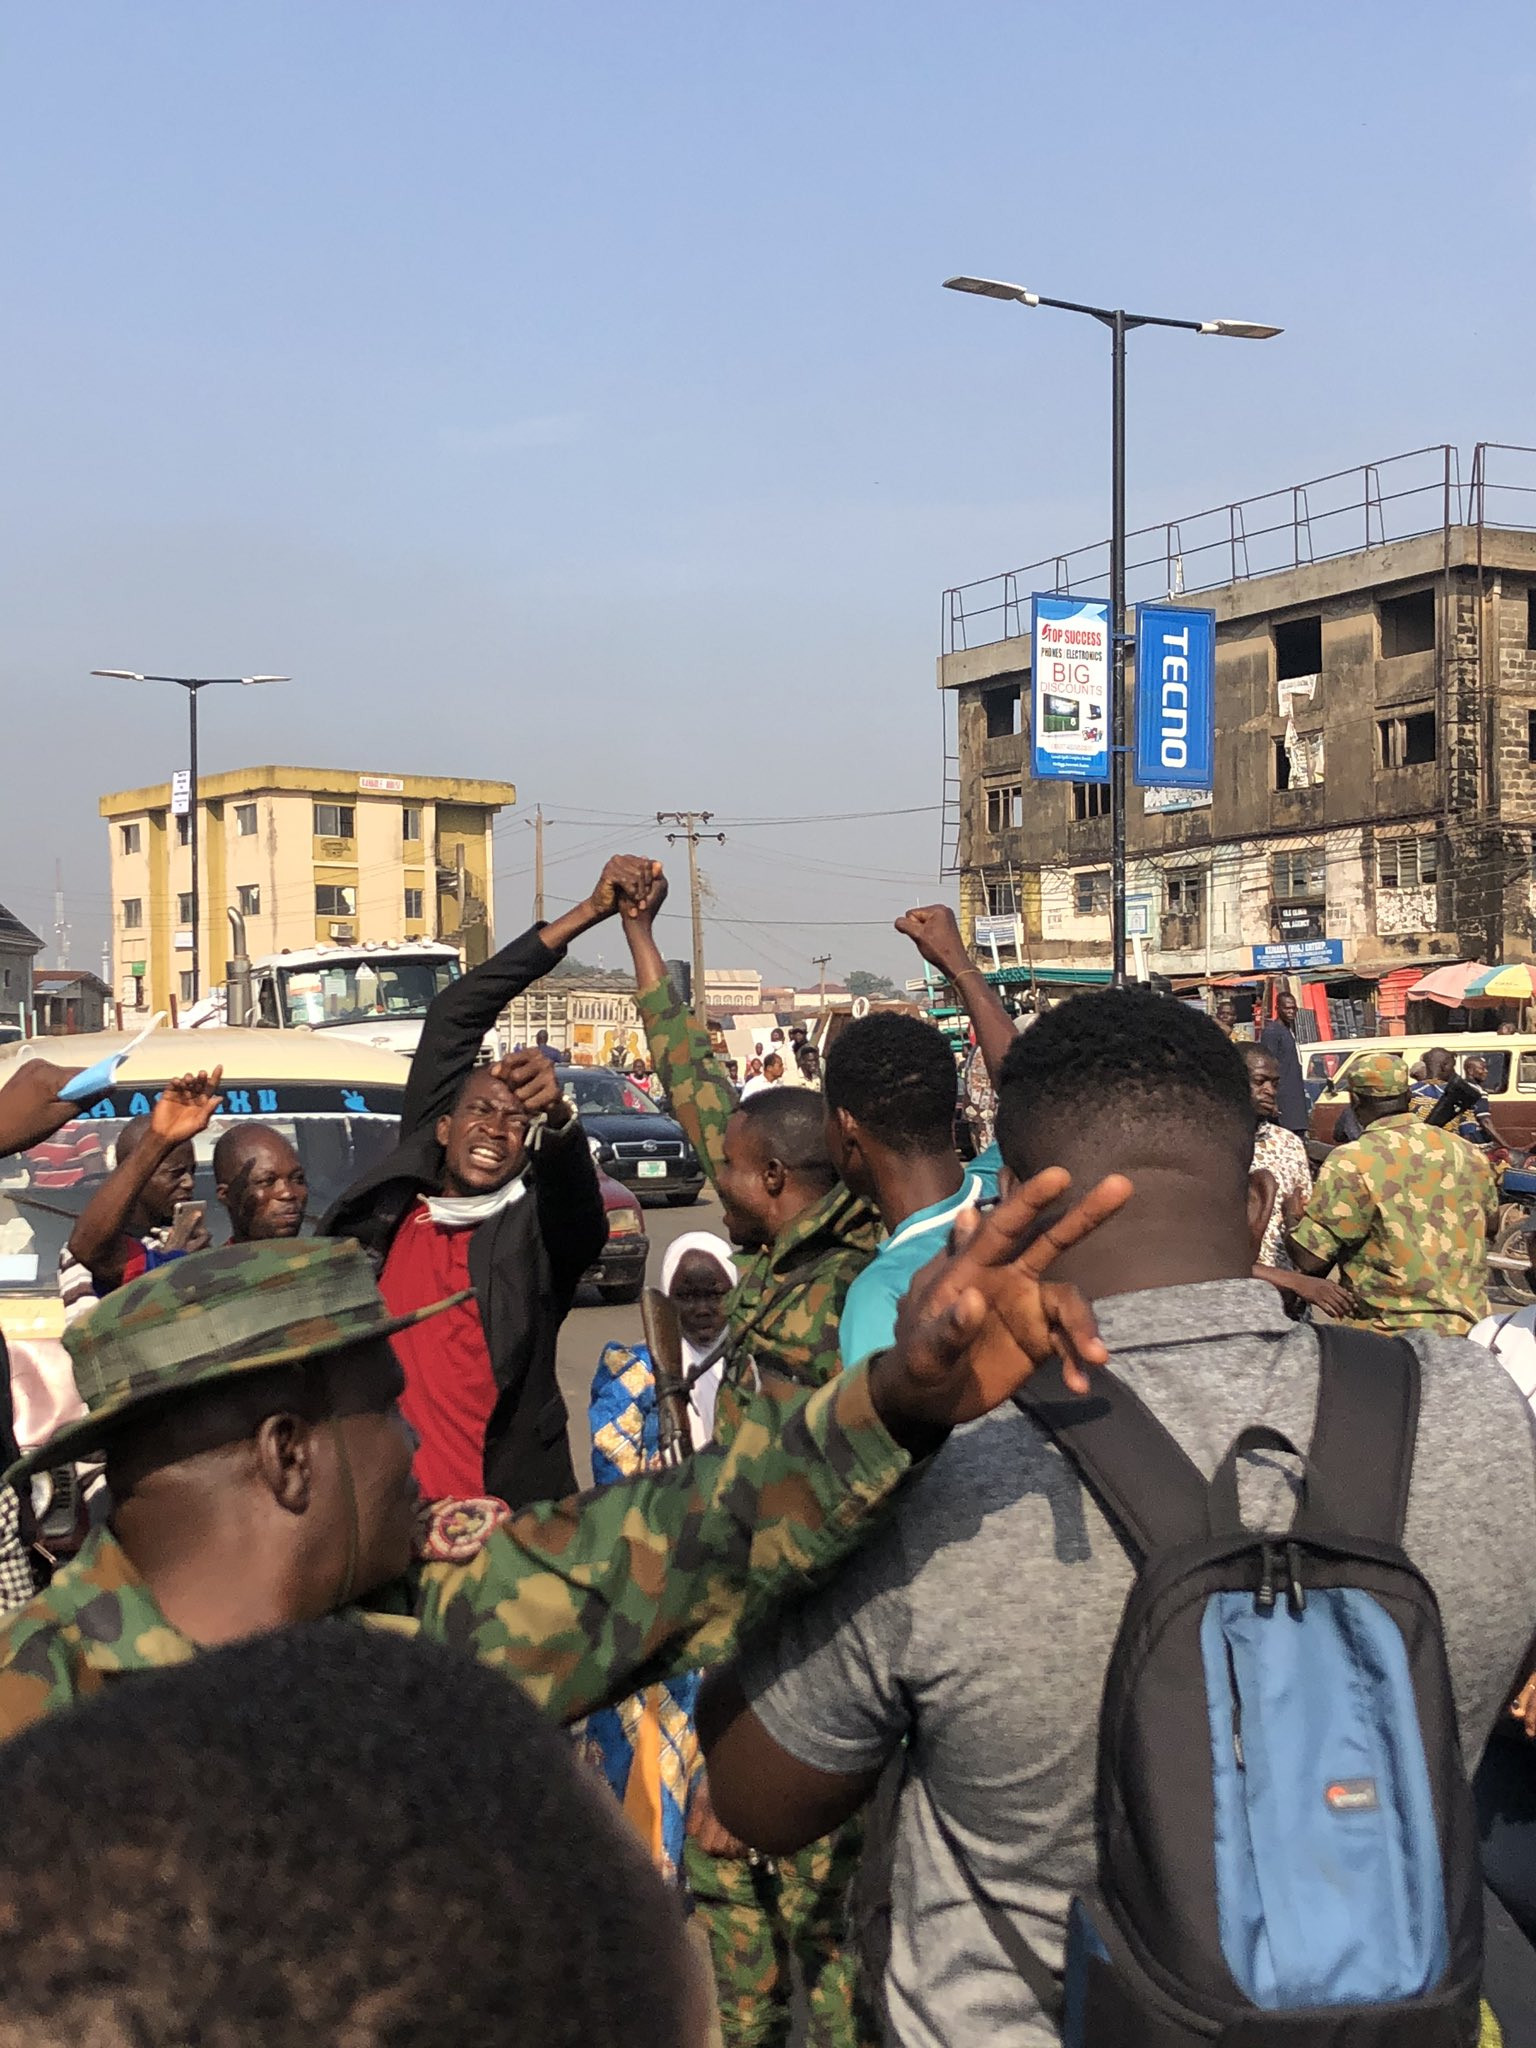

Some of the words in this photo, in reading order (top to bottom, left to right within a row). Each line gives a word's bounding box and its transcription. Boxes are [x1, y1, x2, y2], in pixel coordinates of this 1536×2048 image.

[1047, 628, 1063, 642] TOP
[1064, 629, 1102, 647] SUCCESS
[1041, 647, 1063, 659] PHONES
[1066, 648, 1103, 662] ELECTRONICS
[1053, 662, 1090, 684] BIG
[1040, 681, 1103, 696] DISCOUNTS
[1160, 626, 1190, 769] TECNO
